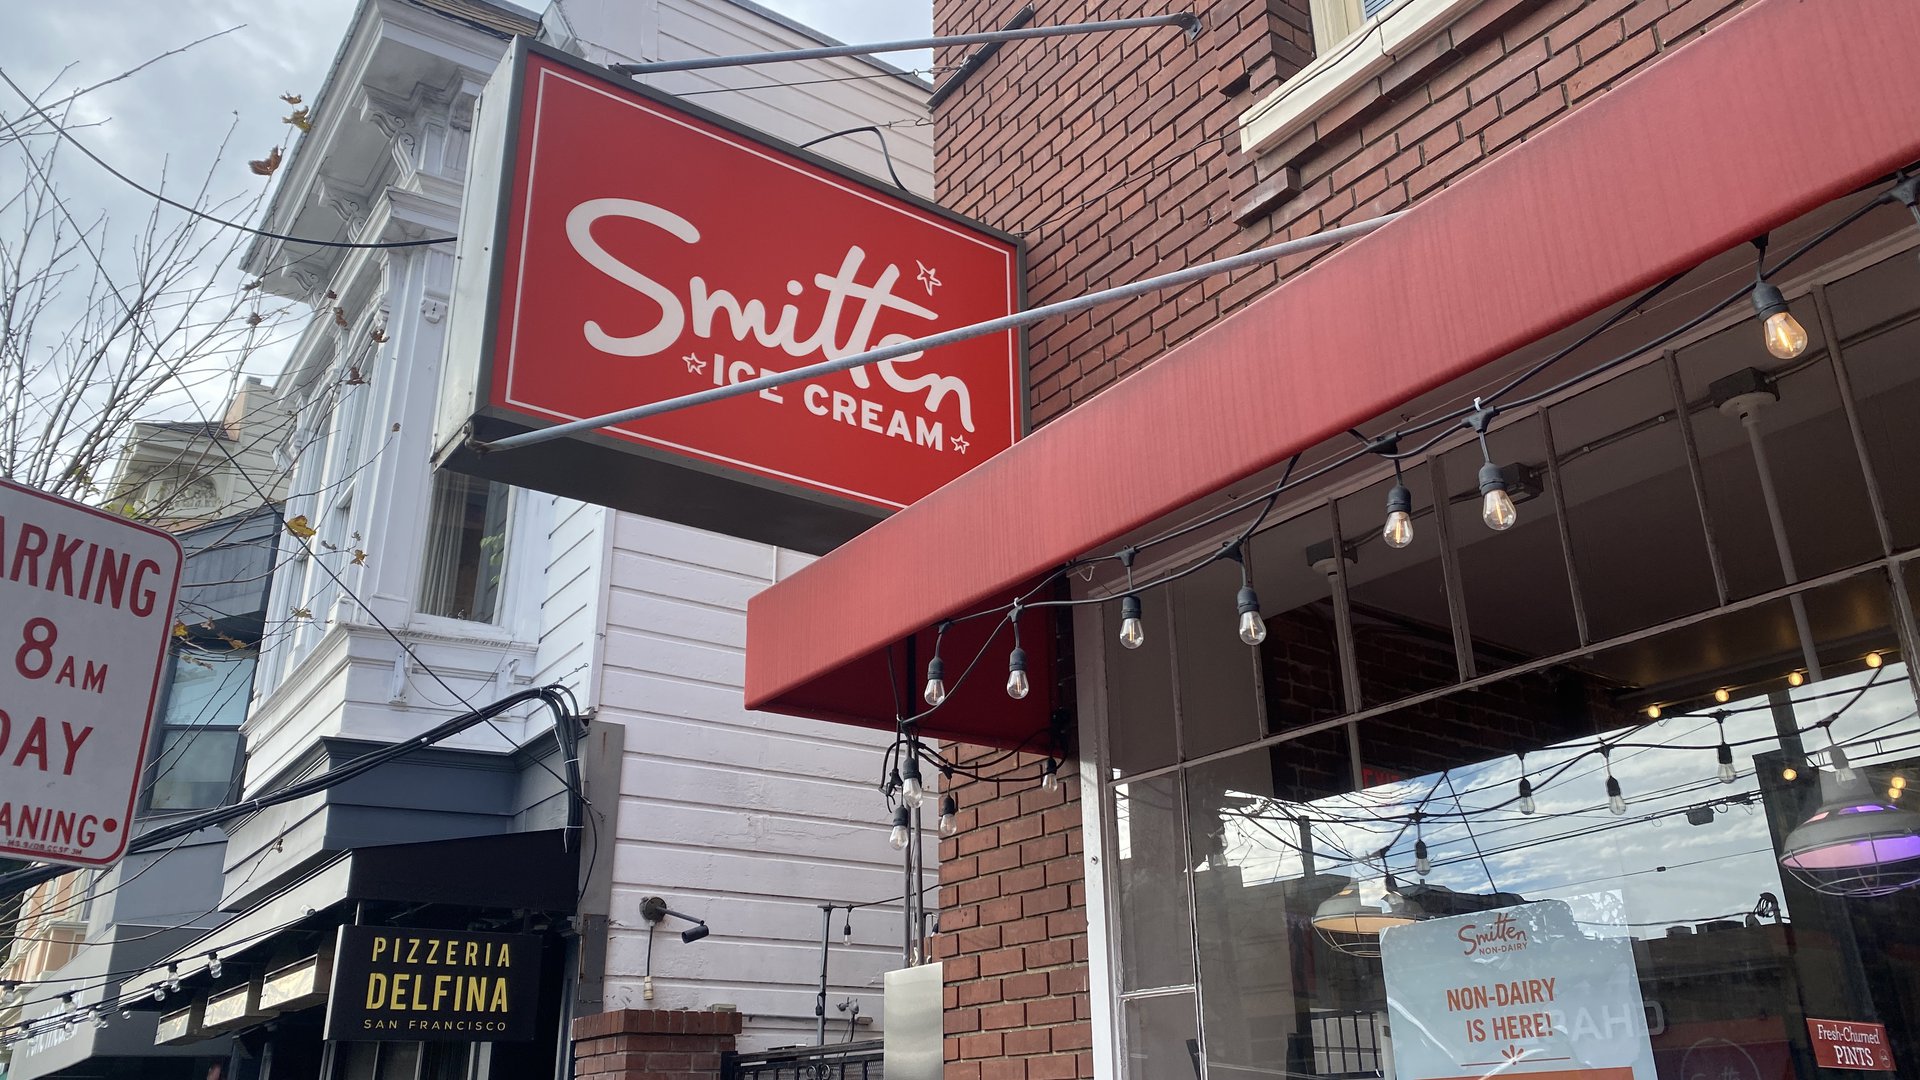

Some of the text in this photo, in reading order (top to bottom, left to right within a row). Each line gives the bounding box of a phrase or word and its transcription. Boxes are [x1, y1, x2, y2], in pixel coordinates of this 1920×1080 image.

[565, 197, 975, 432] Smitten
[713, 353, 943, 451] ICE CREAM
[0, 515, 161, 618] RKING
[15, 616, 108, 694] 8 AM
[1458, 912, 1528, 955] Smitten
[1479, 942, 1528, 956] NON-DAIRY
[371, 936, 511, 968] PIZZERIA
[365, 972, 508, 1013] DELFINA
[1446, 977, 1556, 1012] NON-DAIRY
[363, 1019, 506, 1032] SAN FRANCISCO
[1466, 1012, 1553, 1043] IS HERE!
[1817, 1024, 1881, 1045] Fresh-Churned
[1833, 1045, 1874, 1067] PINTS
